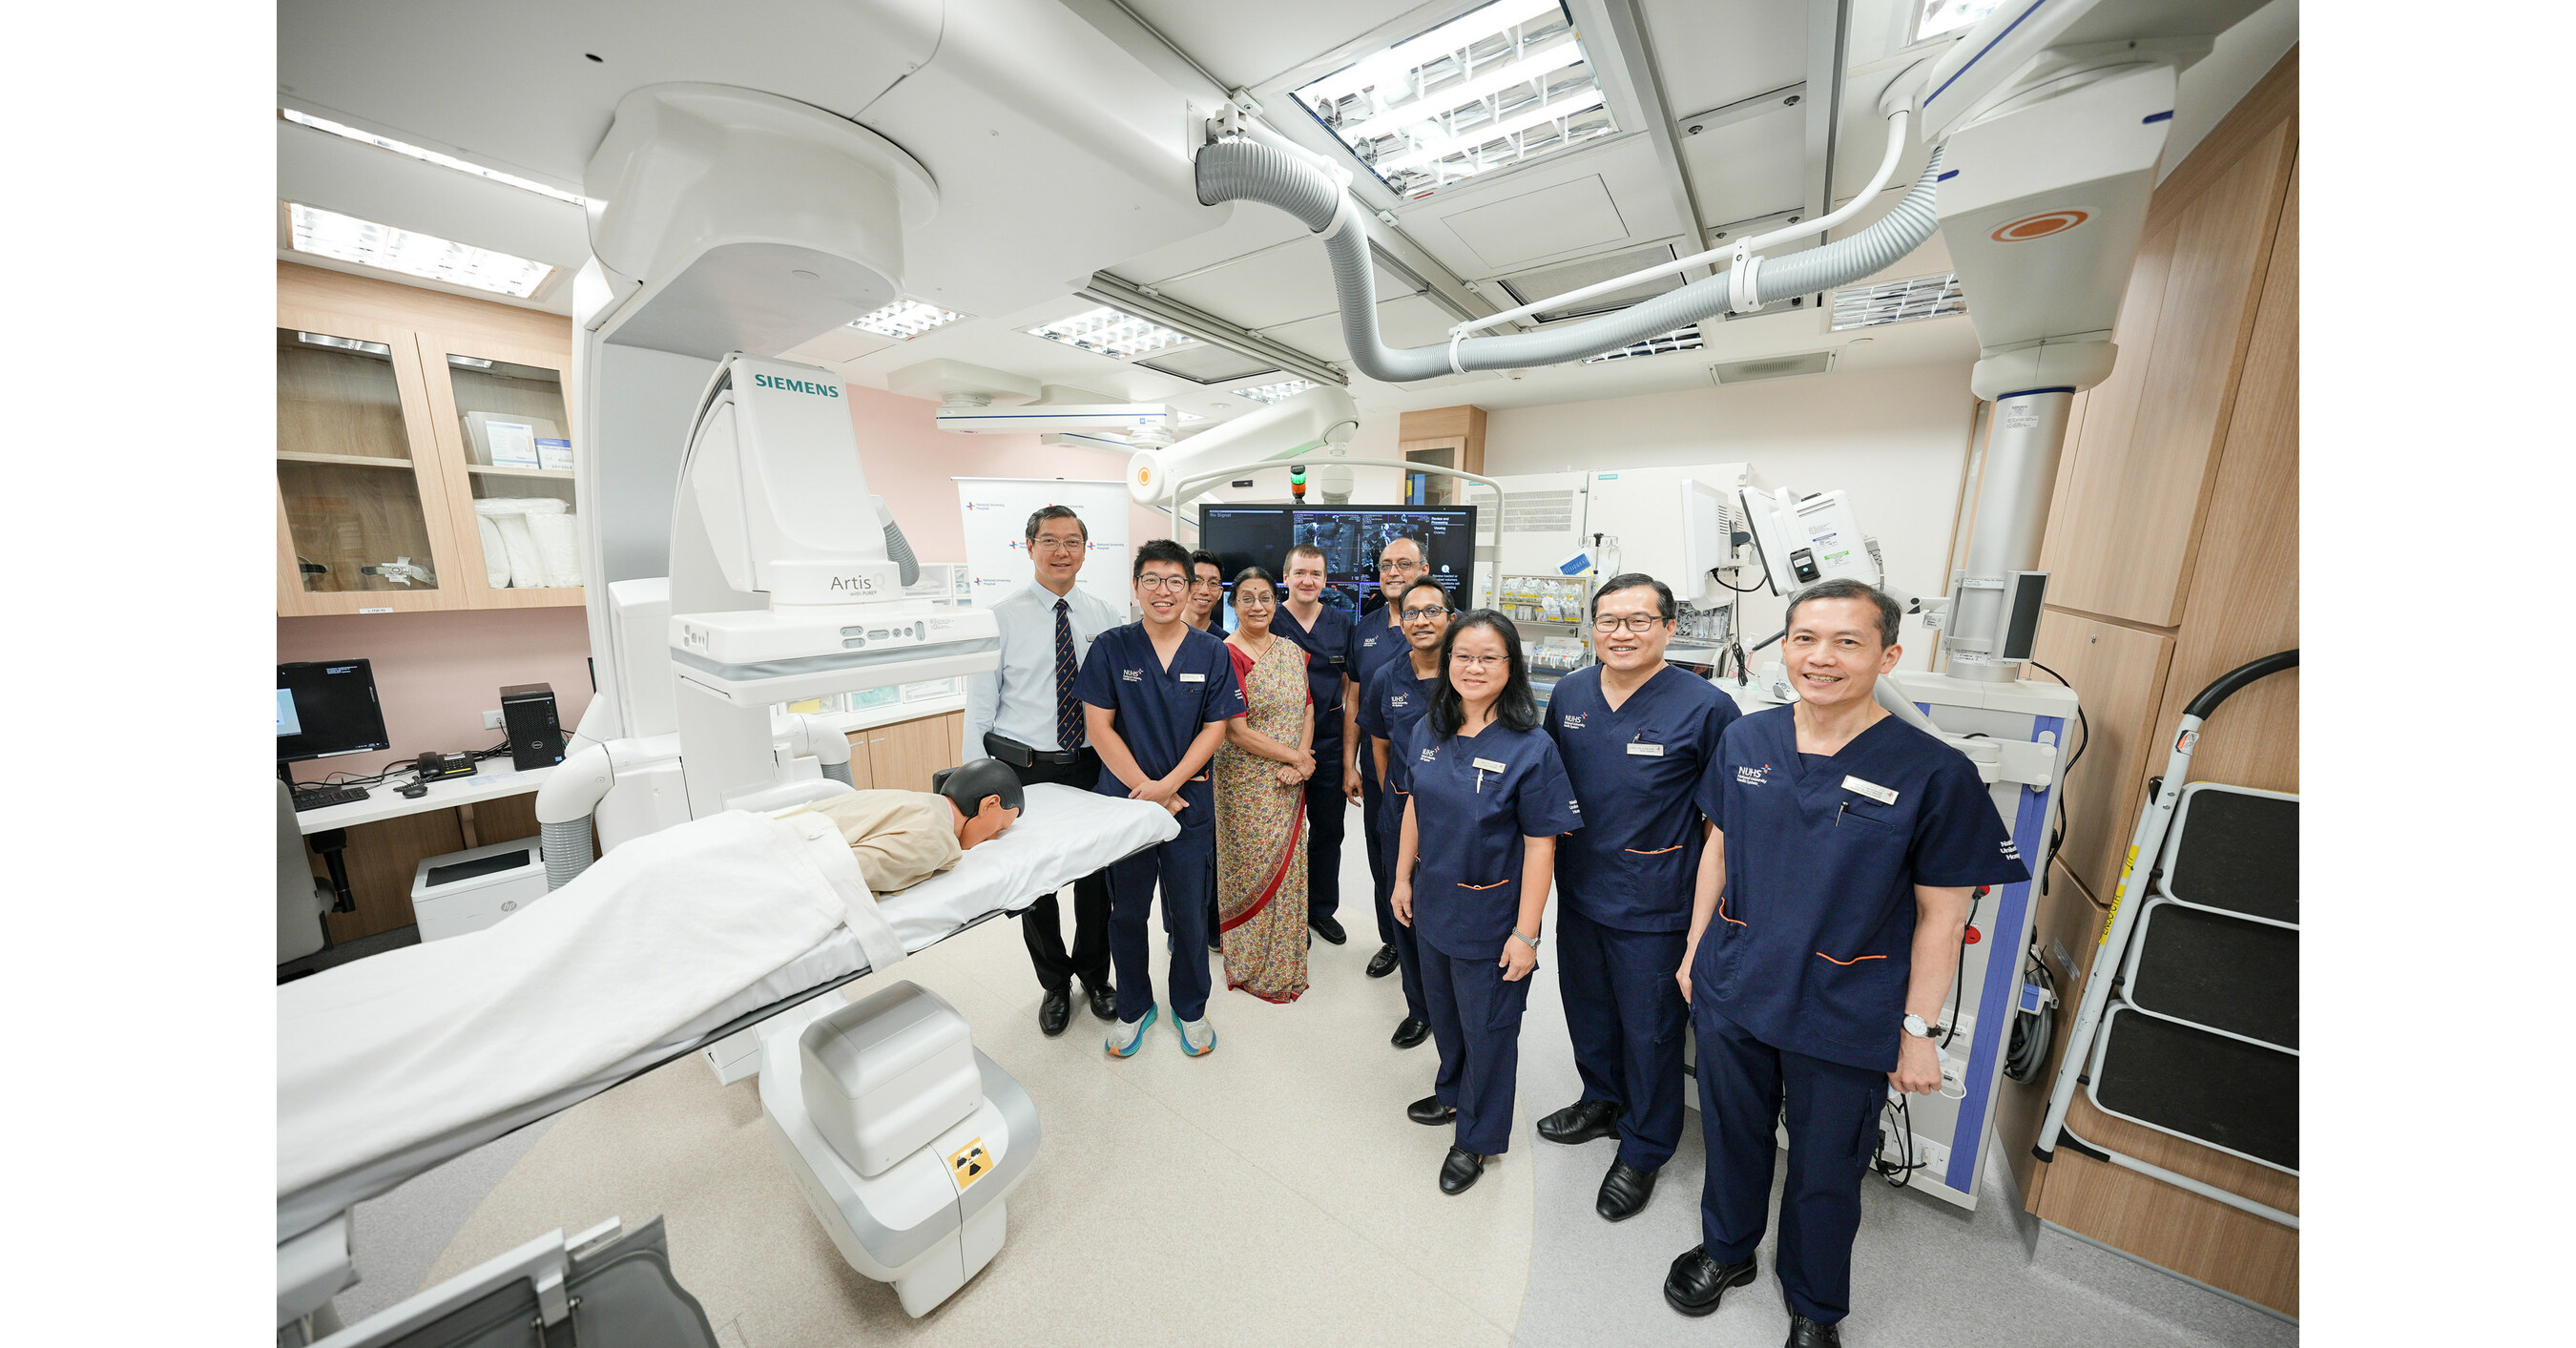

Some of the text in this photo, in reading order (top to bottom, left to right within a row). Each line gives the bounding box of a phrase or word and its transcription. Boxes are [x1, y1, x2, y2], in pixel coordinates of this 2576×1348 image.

[755, 374, 840, 398] SIEMENS
[830, 574, 872, 591] Artis
[1565, 715, 1581, 723] NUHS
[1738, 766, 1762, 778] NUHS
